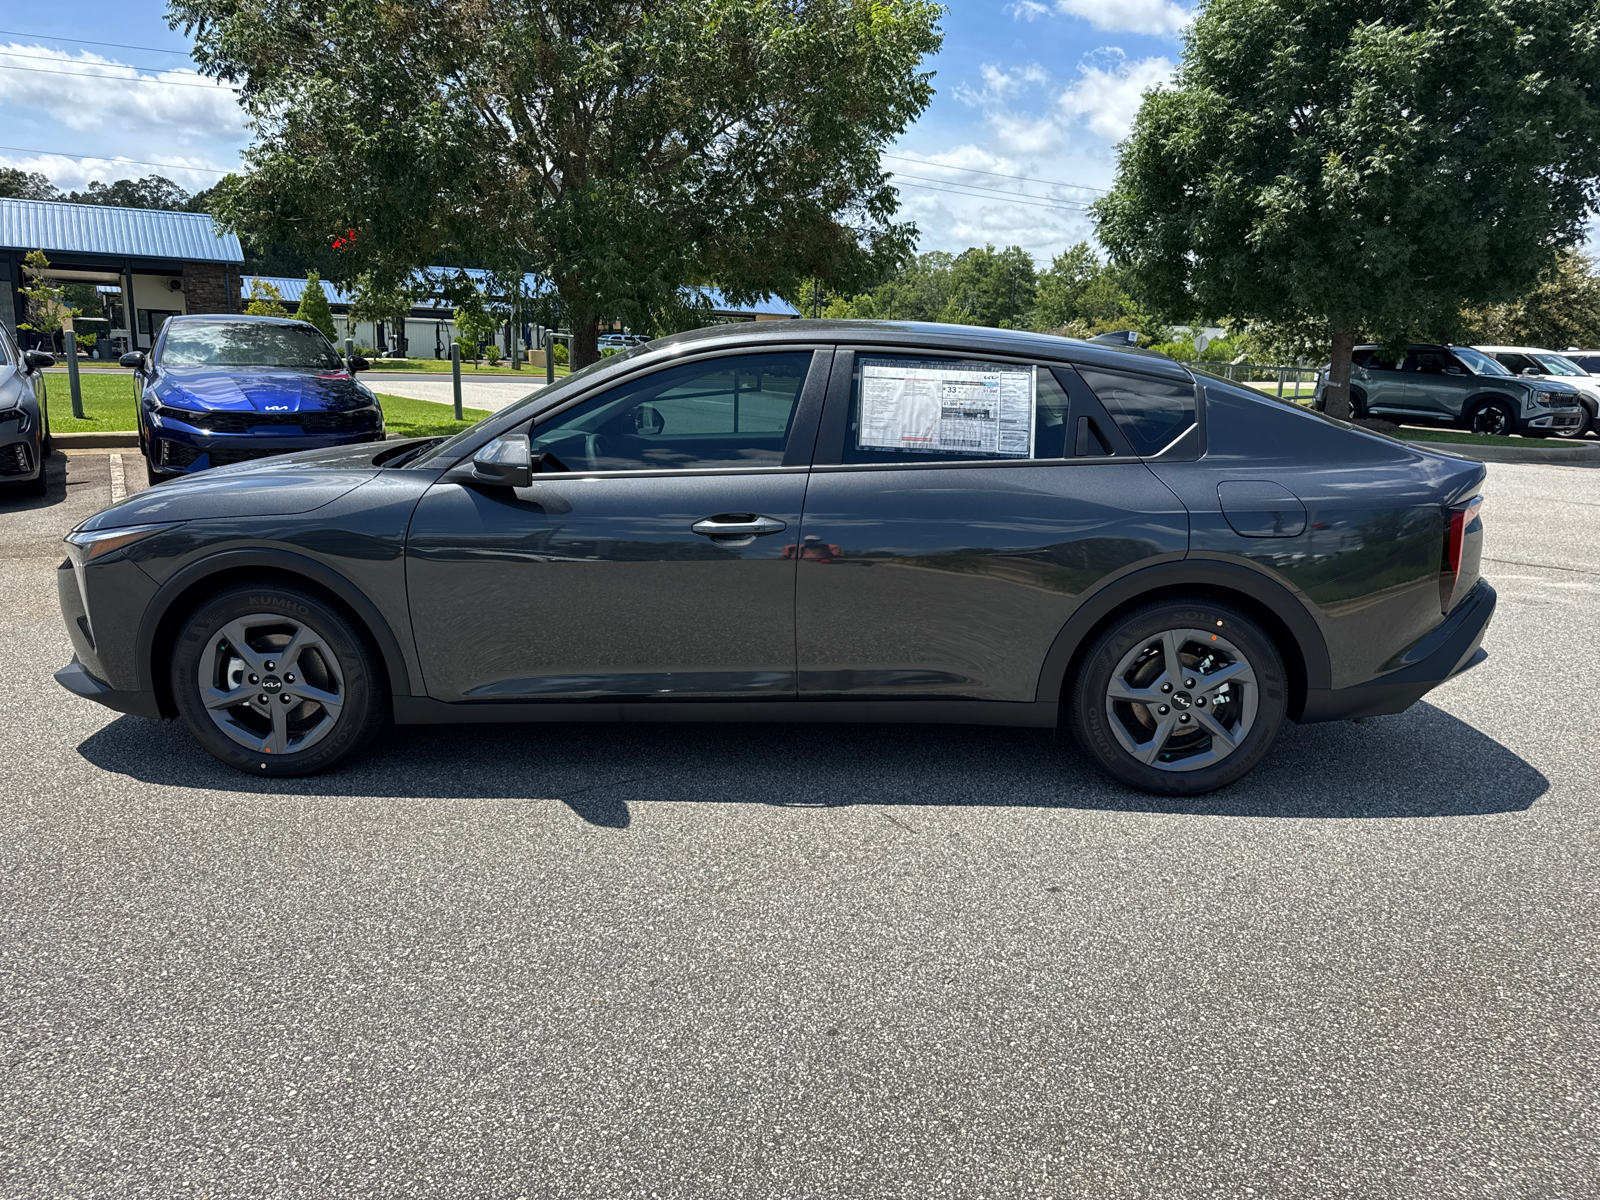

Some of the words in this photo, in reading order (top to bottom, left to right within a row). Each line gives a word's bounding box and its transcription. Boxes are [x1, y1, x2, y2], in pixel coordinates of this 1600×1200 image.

[947, 386, 957, 394] 33
[249, 596, 309, 615] KUMHO
[1173, 694, 1190, 708] KIA
[312, 722, 353, 763] SOLUS
[1088, 707, 1118, 761] KUMHO
